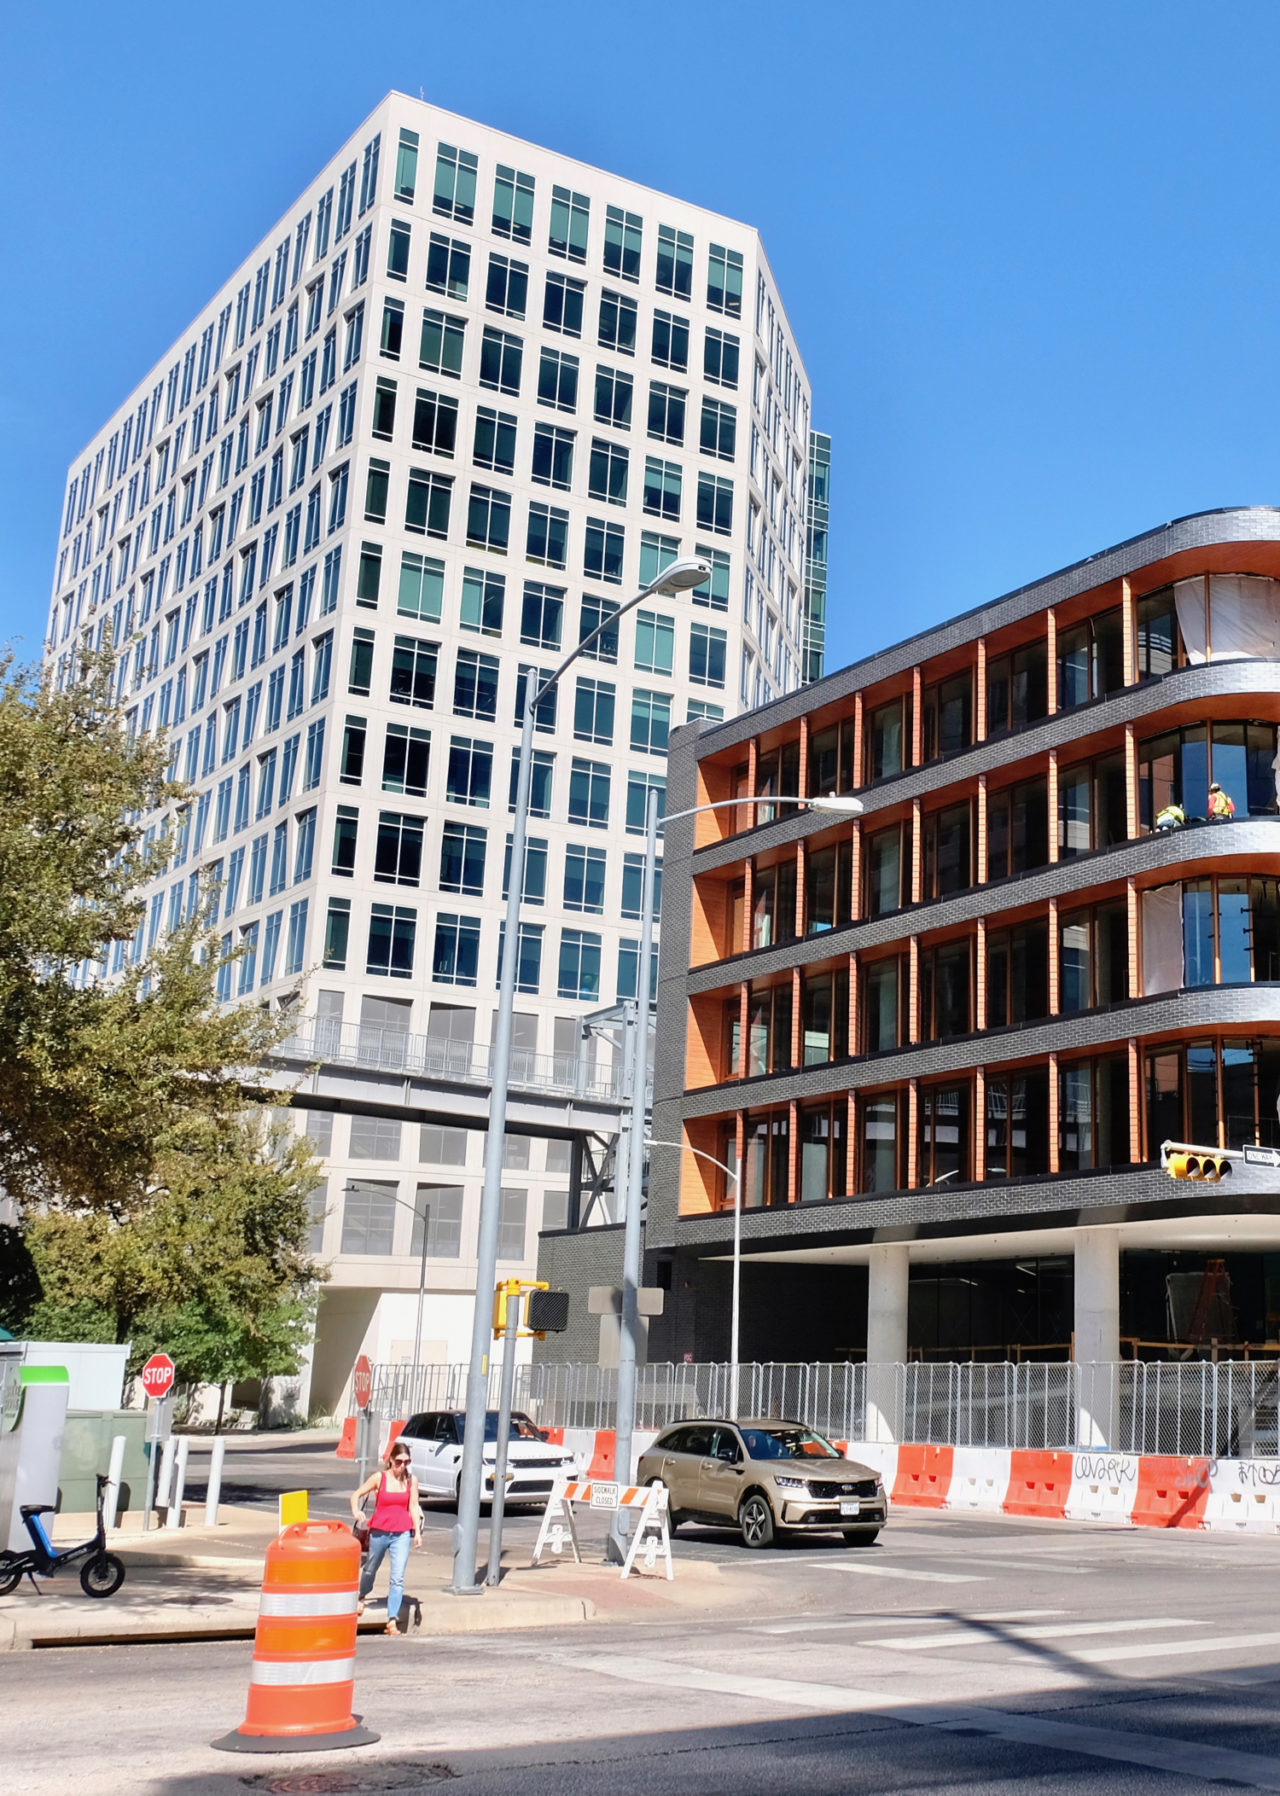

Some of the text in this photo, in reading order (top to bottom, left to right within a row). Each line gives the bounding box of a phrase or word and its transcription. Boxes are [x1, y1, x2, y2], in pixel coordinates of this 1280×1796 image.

[1248, 1152, 1261, 1160] ONE
[143, 1367, 172, 1385] STOP
[355, 1371, 370, 1392] STOP
[595, 1496, 614, 1505] CLOSED
